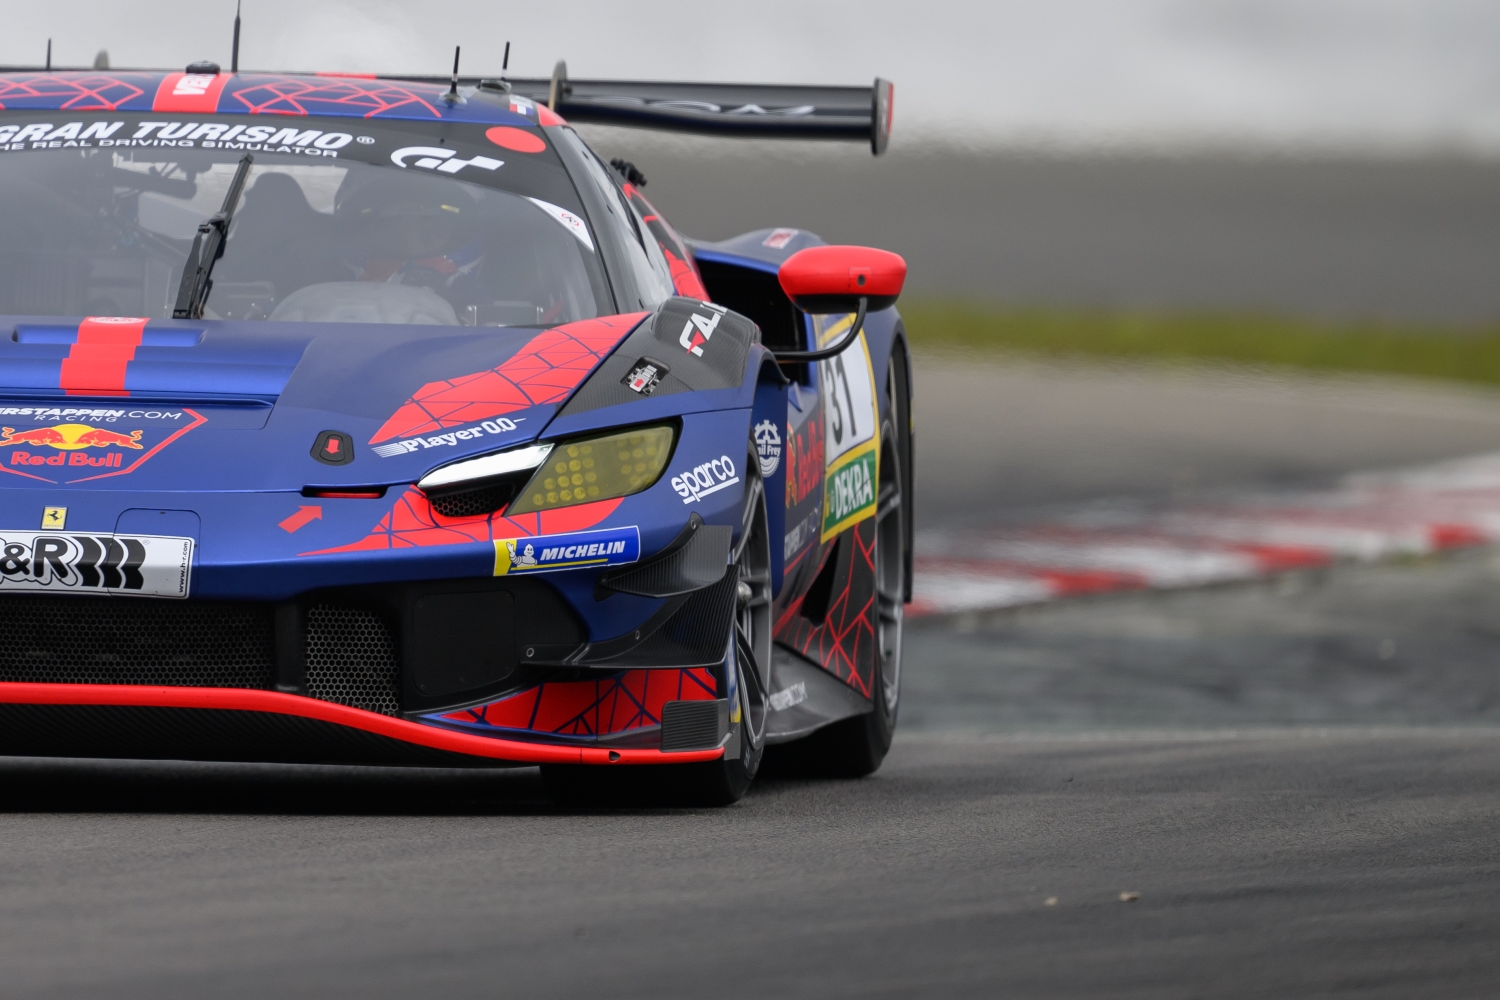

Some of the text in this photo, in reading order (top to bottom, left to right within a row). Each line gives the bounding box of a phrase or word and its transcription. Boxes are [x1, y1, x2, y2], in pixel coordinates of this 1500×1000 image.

[32, 139, 92, 149] REAL
[98, 138, 194, 148] DRIVING
[201, 140, 338, 158] SIMULATOR
[825, 353, 858, 446] 31
[33, 415, 118, 423] RACING
[399, 426, 484, 453] Player
[10, 451, 123, 468] Red Bull
[671, 455, 736, 502] sparco
[834, 458, 874, 521] DEKRA
[539, 540, 626, 561] MICHELIN
